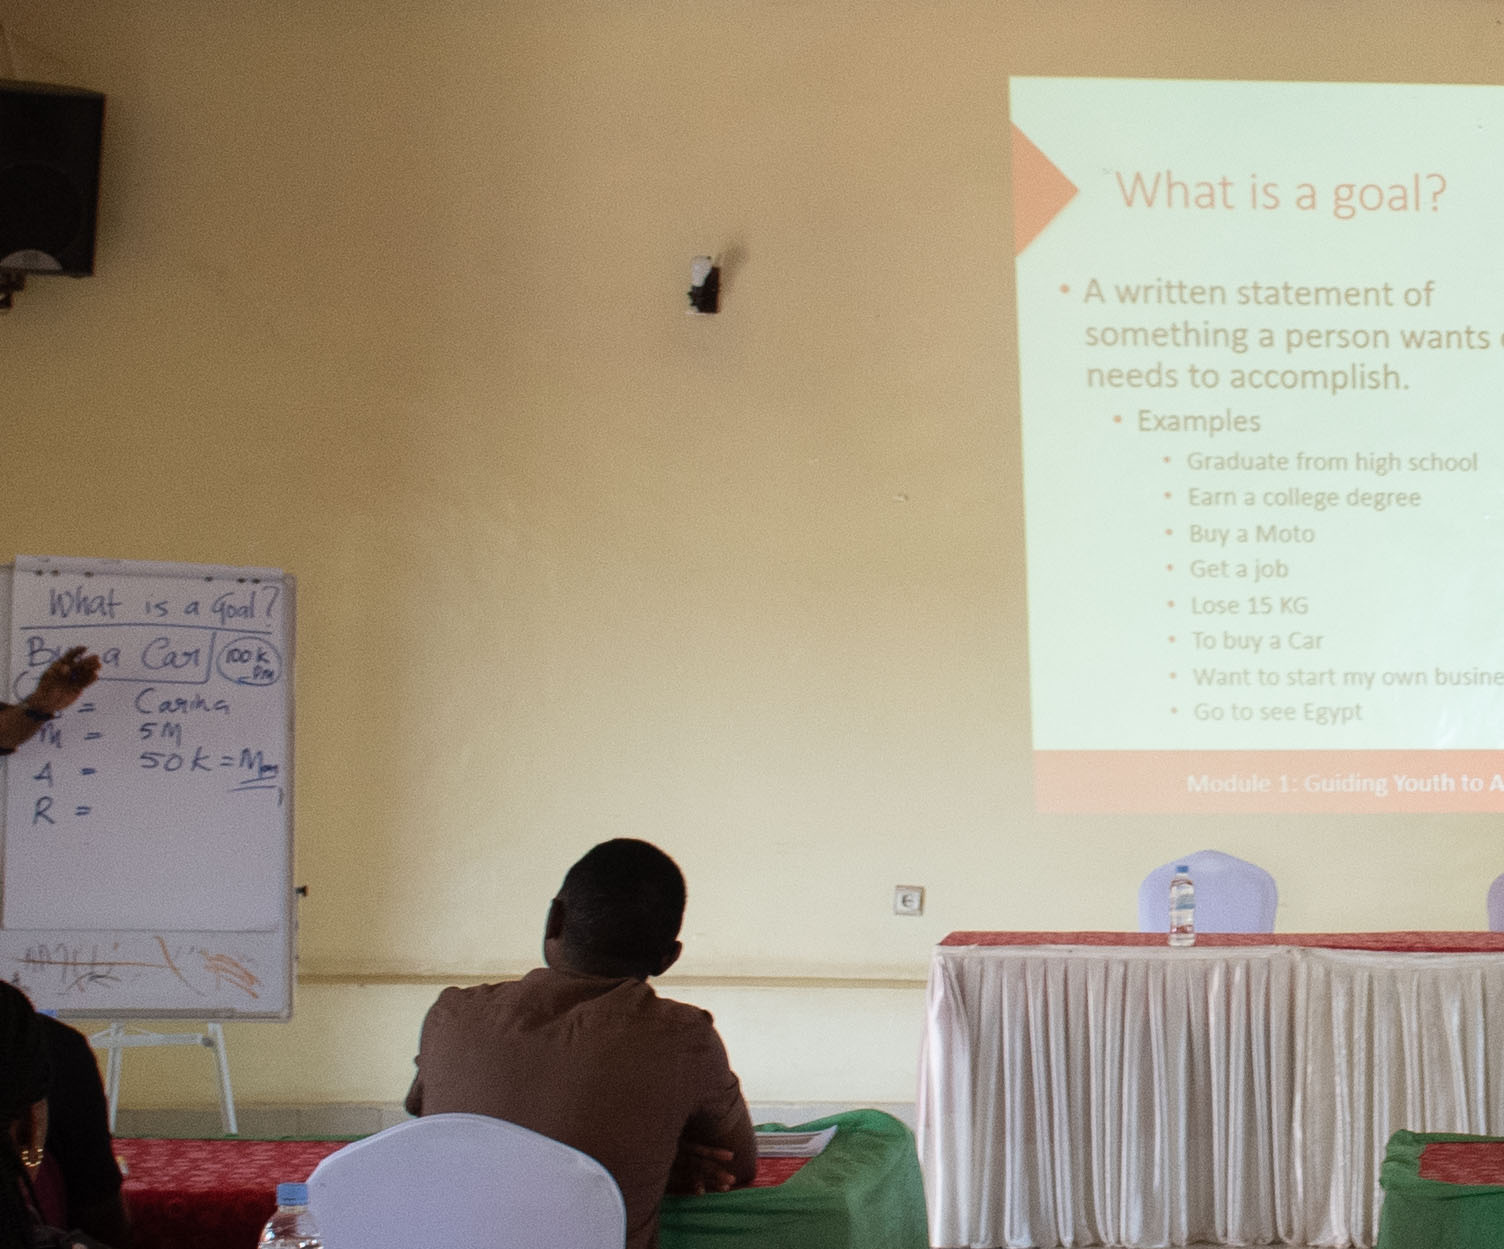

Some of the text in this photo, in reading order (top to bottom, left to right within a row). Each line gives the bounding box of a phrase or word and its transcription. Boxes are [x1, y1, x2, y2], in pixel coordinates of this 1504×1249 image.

[1114, 168, 1448, 221] What is a goal?
[1082, 276, 1436, 308] A written statement of
[1085, 319, 1250, 356] something
[1258, 327, 1276, 349] a
[1285, 327, 1390, 355] person
[1399, 325, 1492, 351] wants
[1086, 361, 1410, 397] needs to accomplish.
[1137, 407, 1262, 438] Examples
[1186, 450, 1479, 477] Graduate from high school
[1187, 486, 1422, 513] Earn a college degree
[1188, 523, 1316, 548] Buy a Moto
[1188, 558, 1290, 584] Get a job
[50, 586, 122, 618] What
[145, 600, 169, 617] is
[184, 600, 200, 615] a
[1190, 595, 1310, 616] Lose 15 KG
[102, 647, 121, 667] a
[142, 636, 200, 669] Car
[1191, 630, 1325, 655] To buy a Car
[1191, 667, 1251, 687] Want
[1256, 667, 1281, 687] to
[1286, 667, 1336, 687] start
[1342, 671, 1376, 691] my
[1380, 670, 1429, 687] own
[1192, 701, 1362, 726] Go to see Egypt
[1186, 774, 1272, 793] Module
[1303, 773, 1389, 798] Guiding
[1392, 772, 1456, 793] Youth
[1460, 773, 1485, 793] to
[33, 795, 56, 825] R
